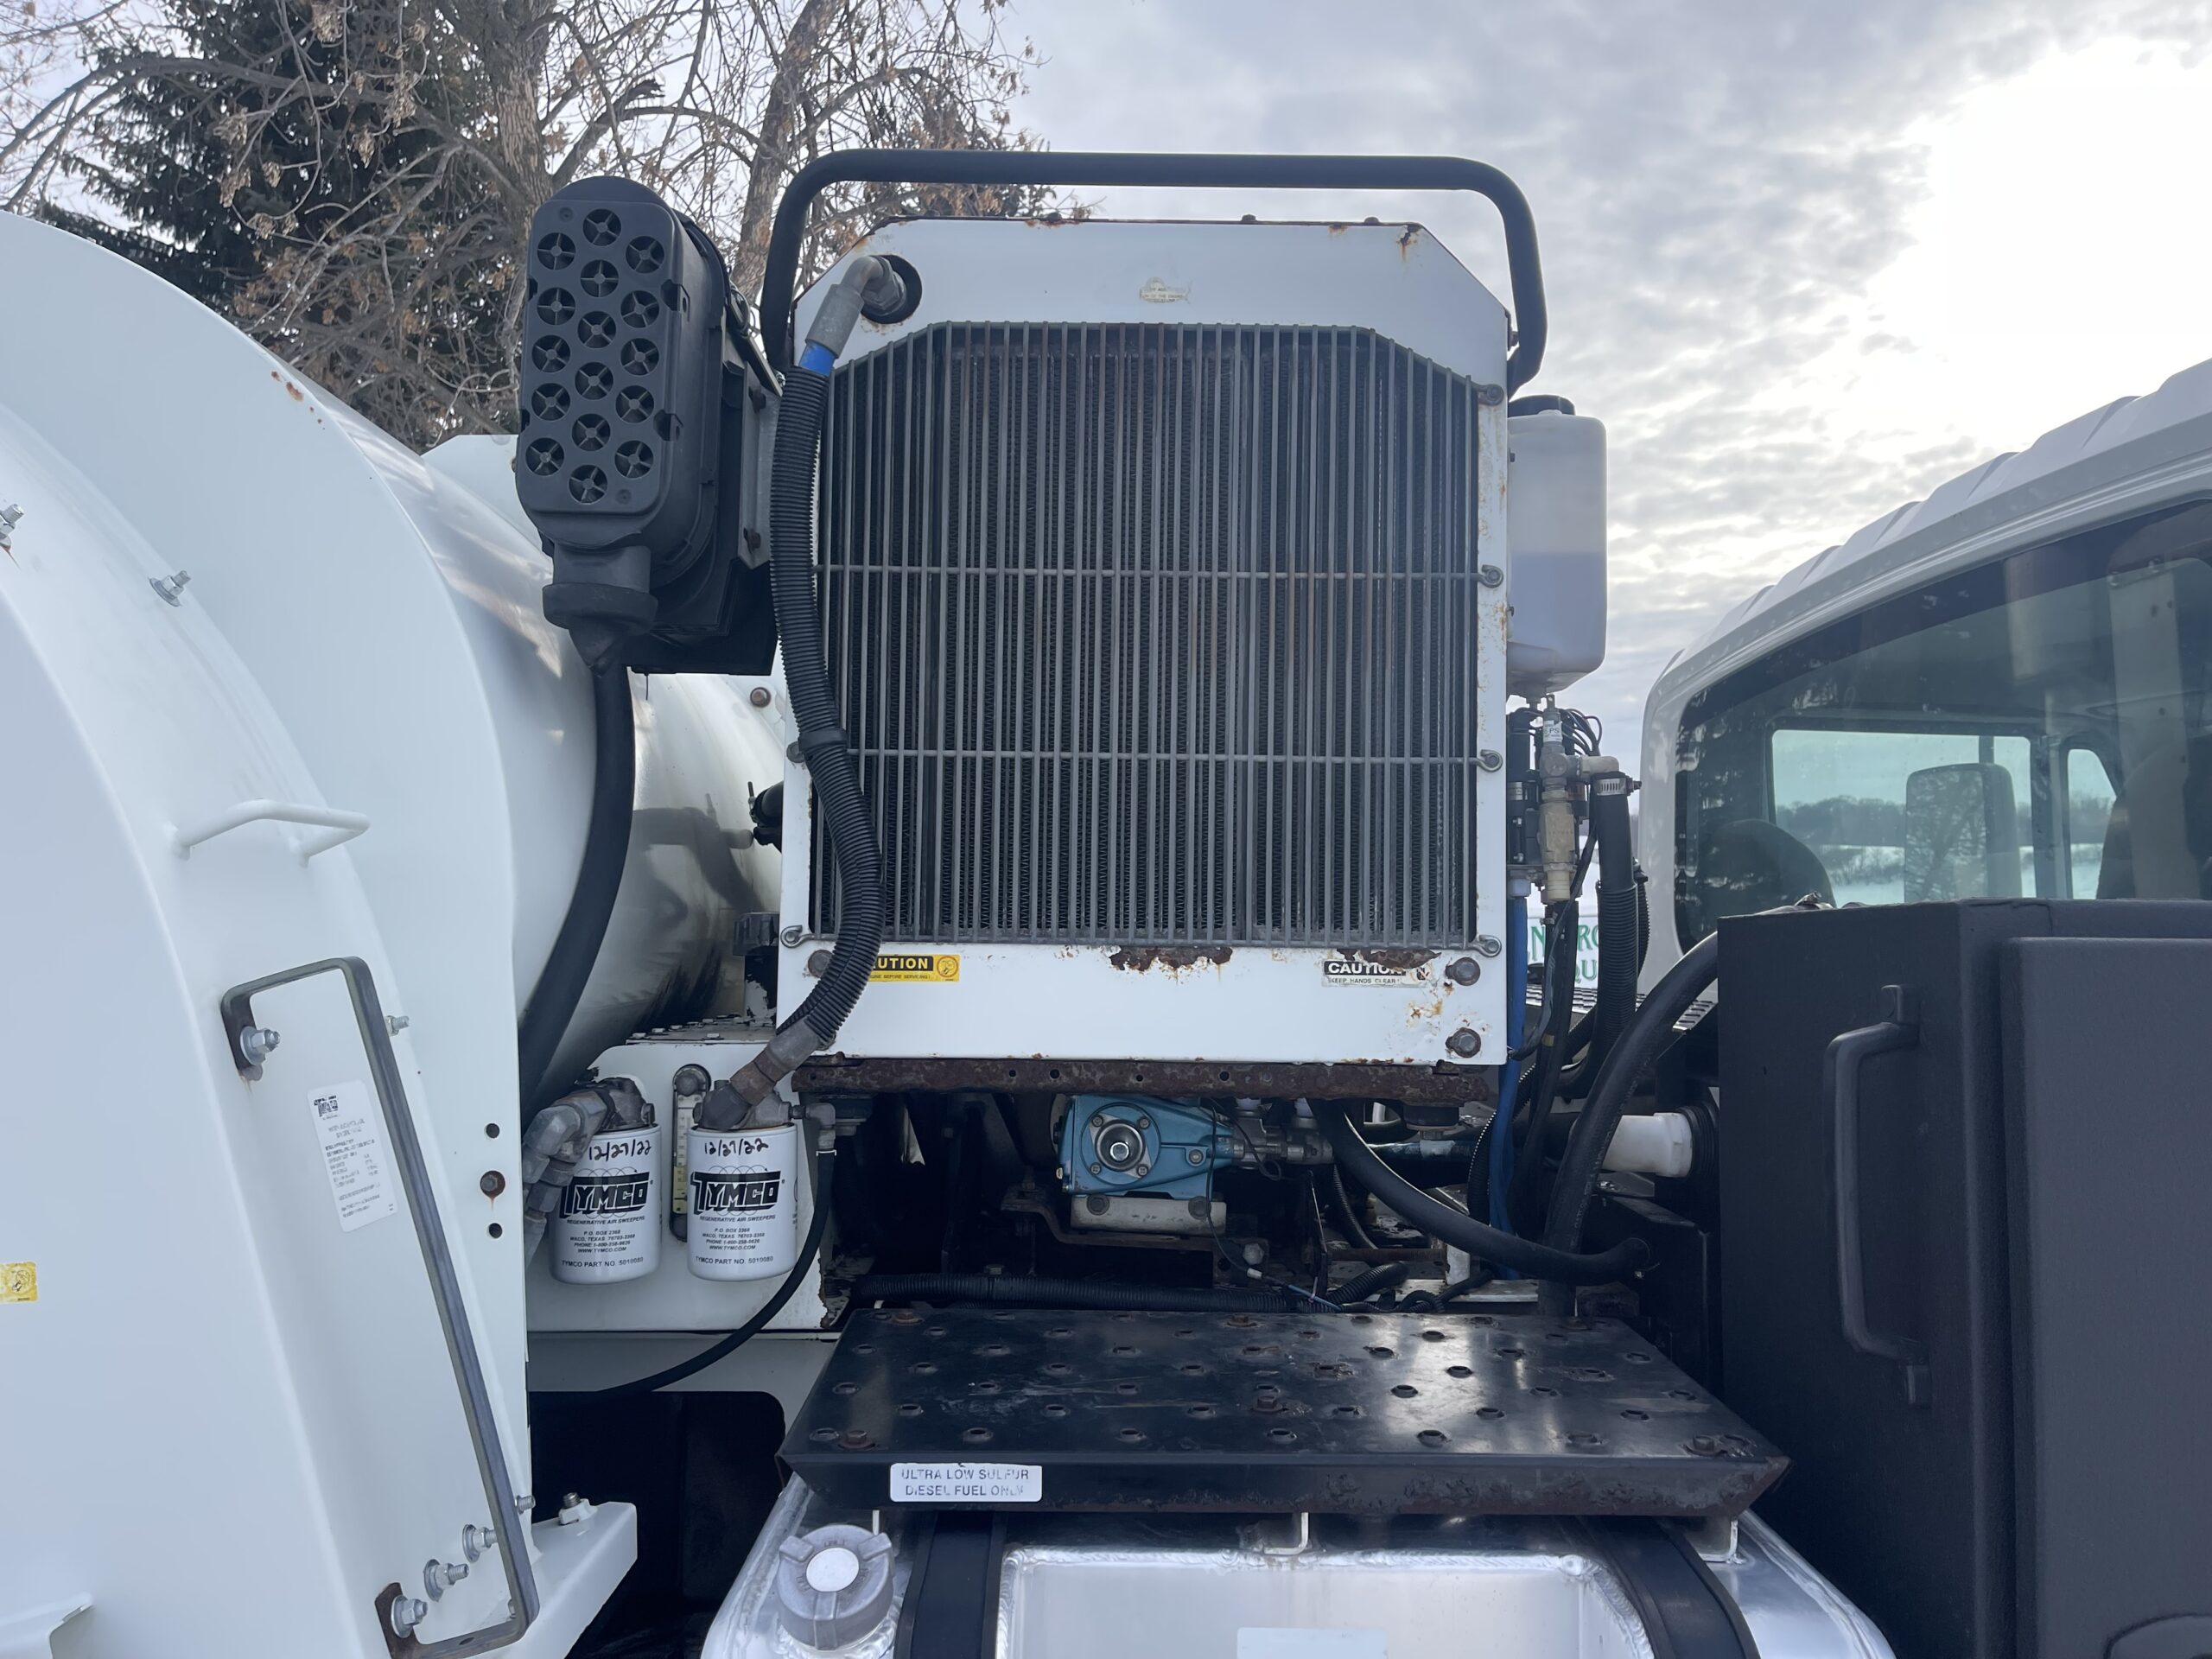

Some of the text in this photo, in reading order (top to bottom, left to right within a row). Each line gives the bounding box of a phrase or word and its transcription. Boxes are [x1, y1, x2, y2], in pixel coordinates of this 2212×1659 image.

[874, 957, 929, 969] UTION
[588, 1138, 652, 1162] 12/27/22
[704, 1137, 769, 1157] 12/27/22
[559, 1171, 651, 1219] TYMCO
[690, 1170, 782, 1216] TYMCO
[618, 1215, 645, 1224] SWEEPERS
[695, 1255, 714, 1264] TYMCO
[901, 1469, 942, 1480] ULTRA
[946, 1469, 975, 1480] LOW
[906, 1485, 950, 1496] DIESEL
[954, 1485, 987, 1496] FUEL
